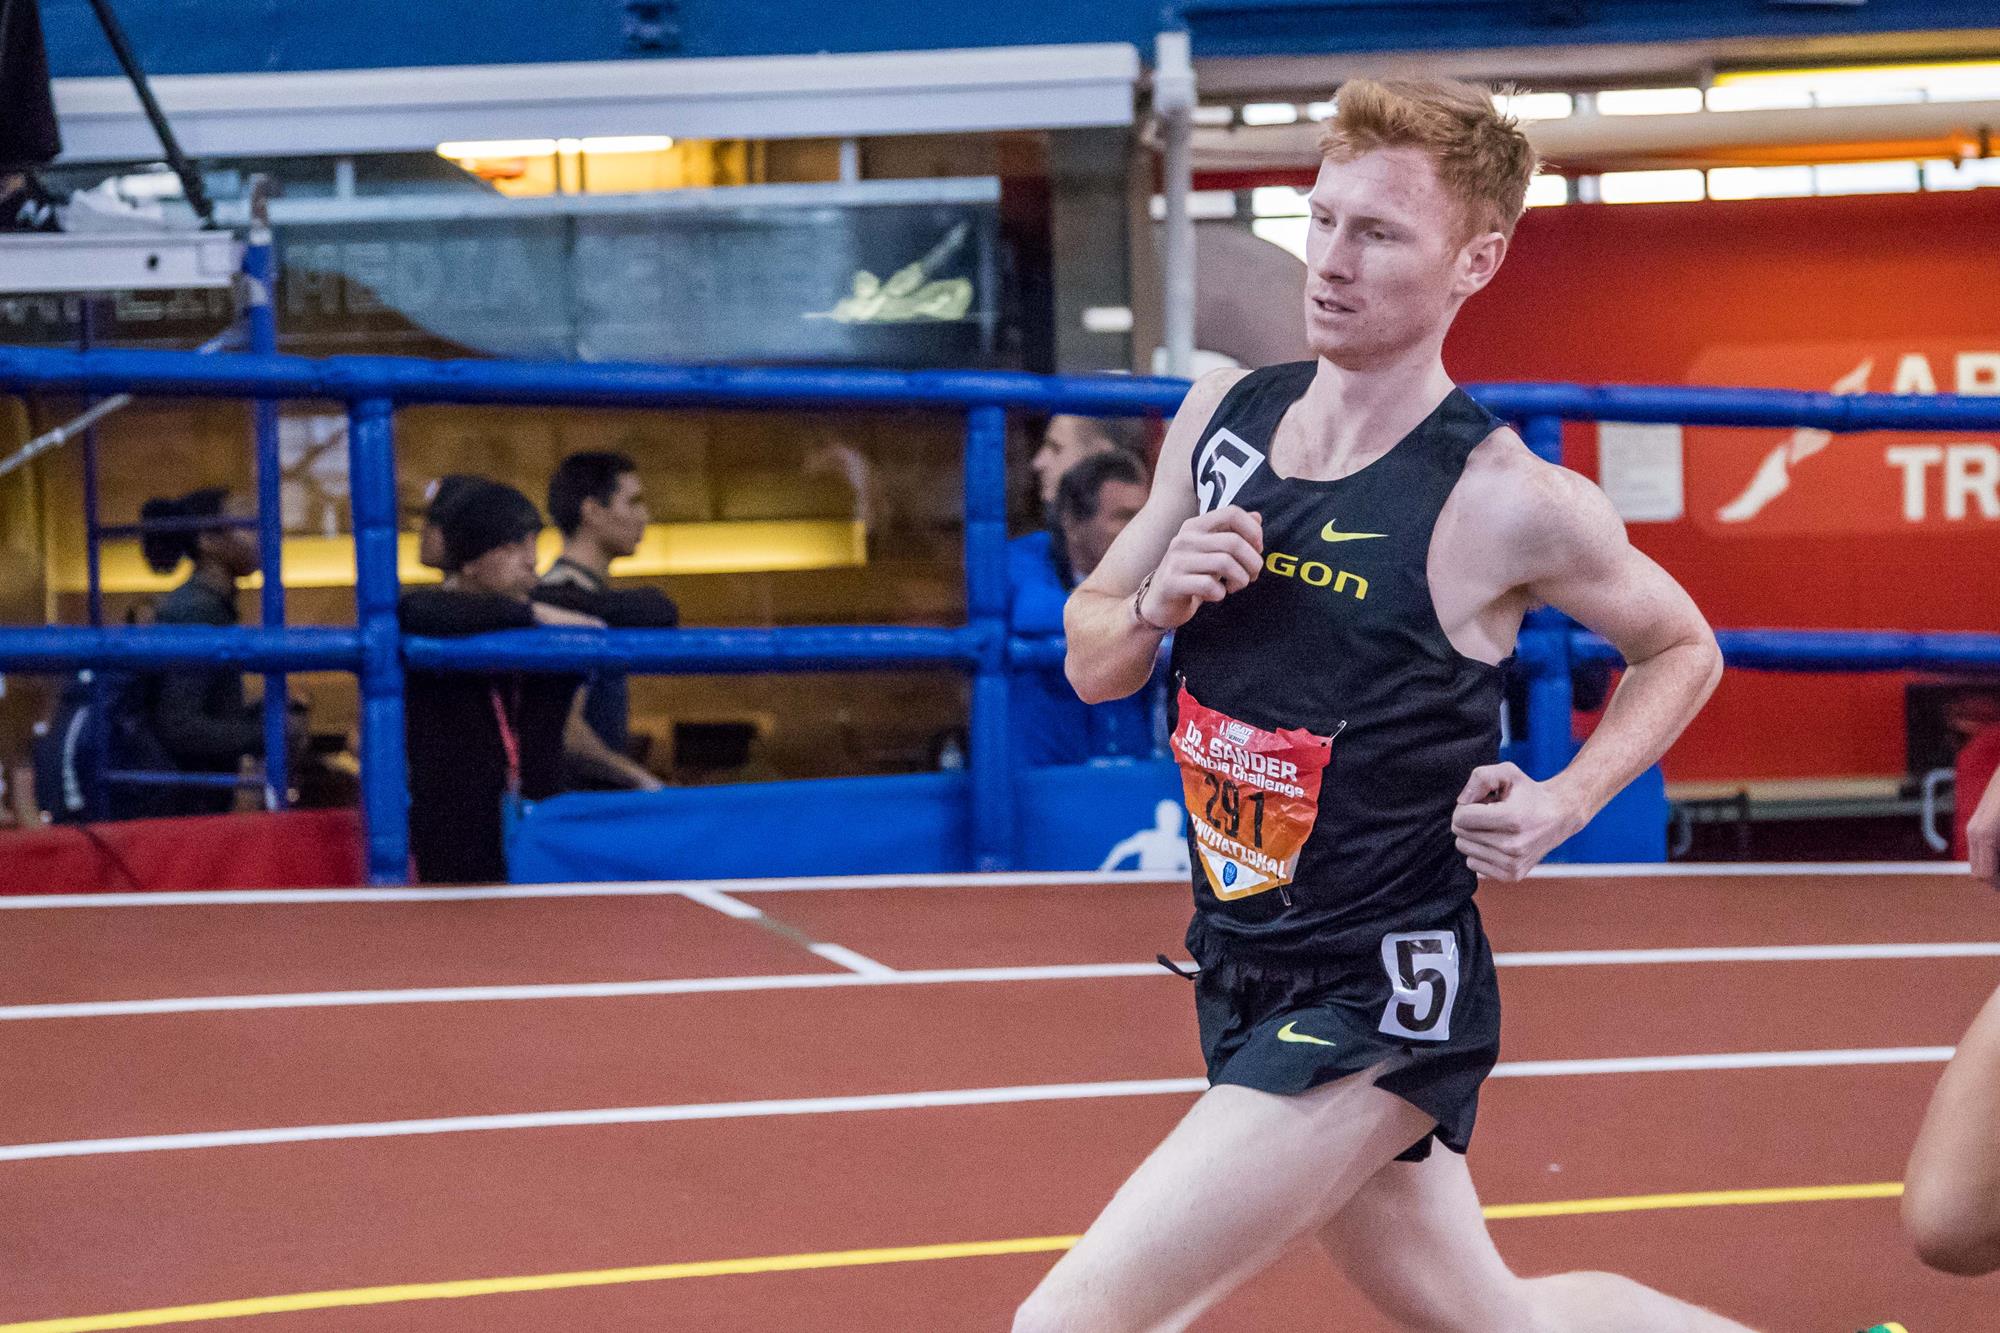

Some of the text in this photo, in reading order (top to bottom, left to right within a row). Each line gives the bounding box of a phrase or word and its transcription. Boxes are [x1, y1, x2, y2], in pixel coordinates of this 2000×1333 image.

[1886, 442, 2000, 523] TR
[1266, 552, 1369, 600] GON
[1209, 737, 1297, 782] SANDER
[1232, 763, 1305, 799] Challenge
[1205, 772, 1264, 849] 291
[1191, 812, 1287, 879] INVITATIONAL
[1395, 938, 1447, 1033] 5
